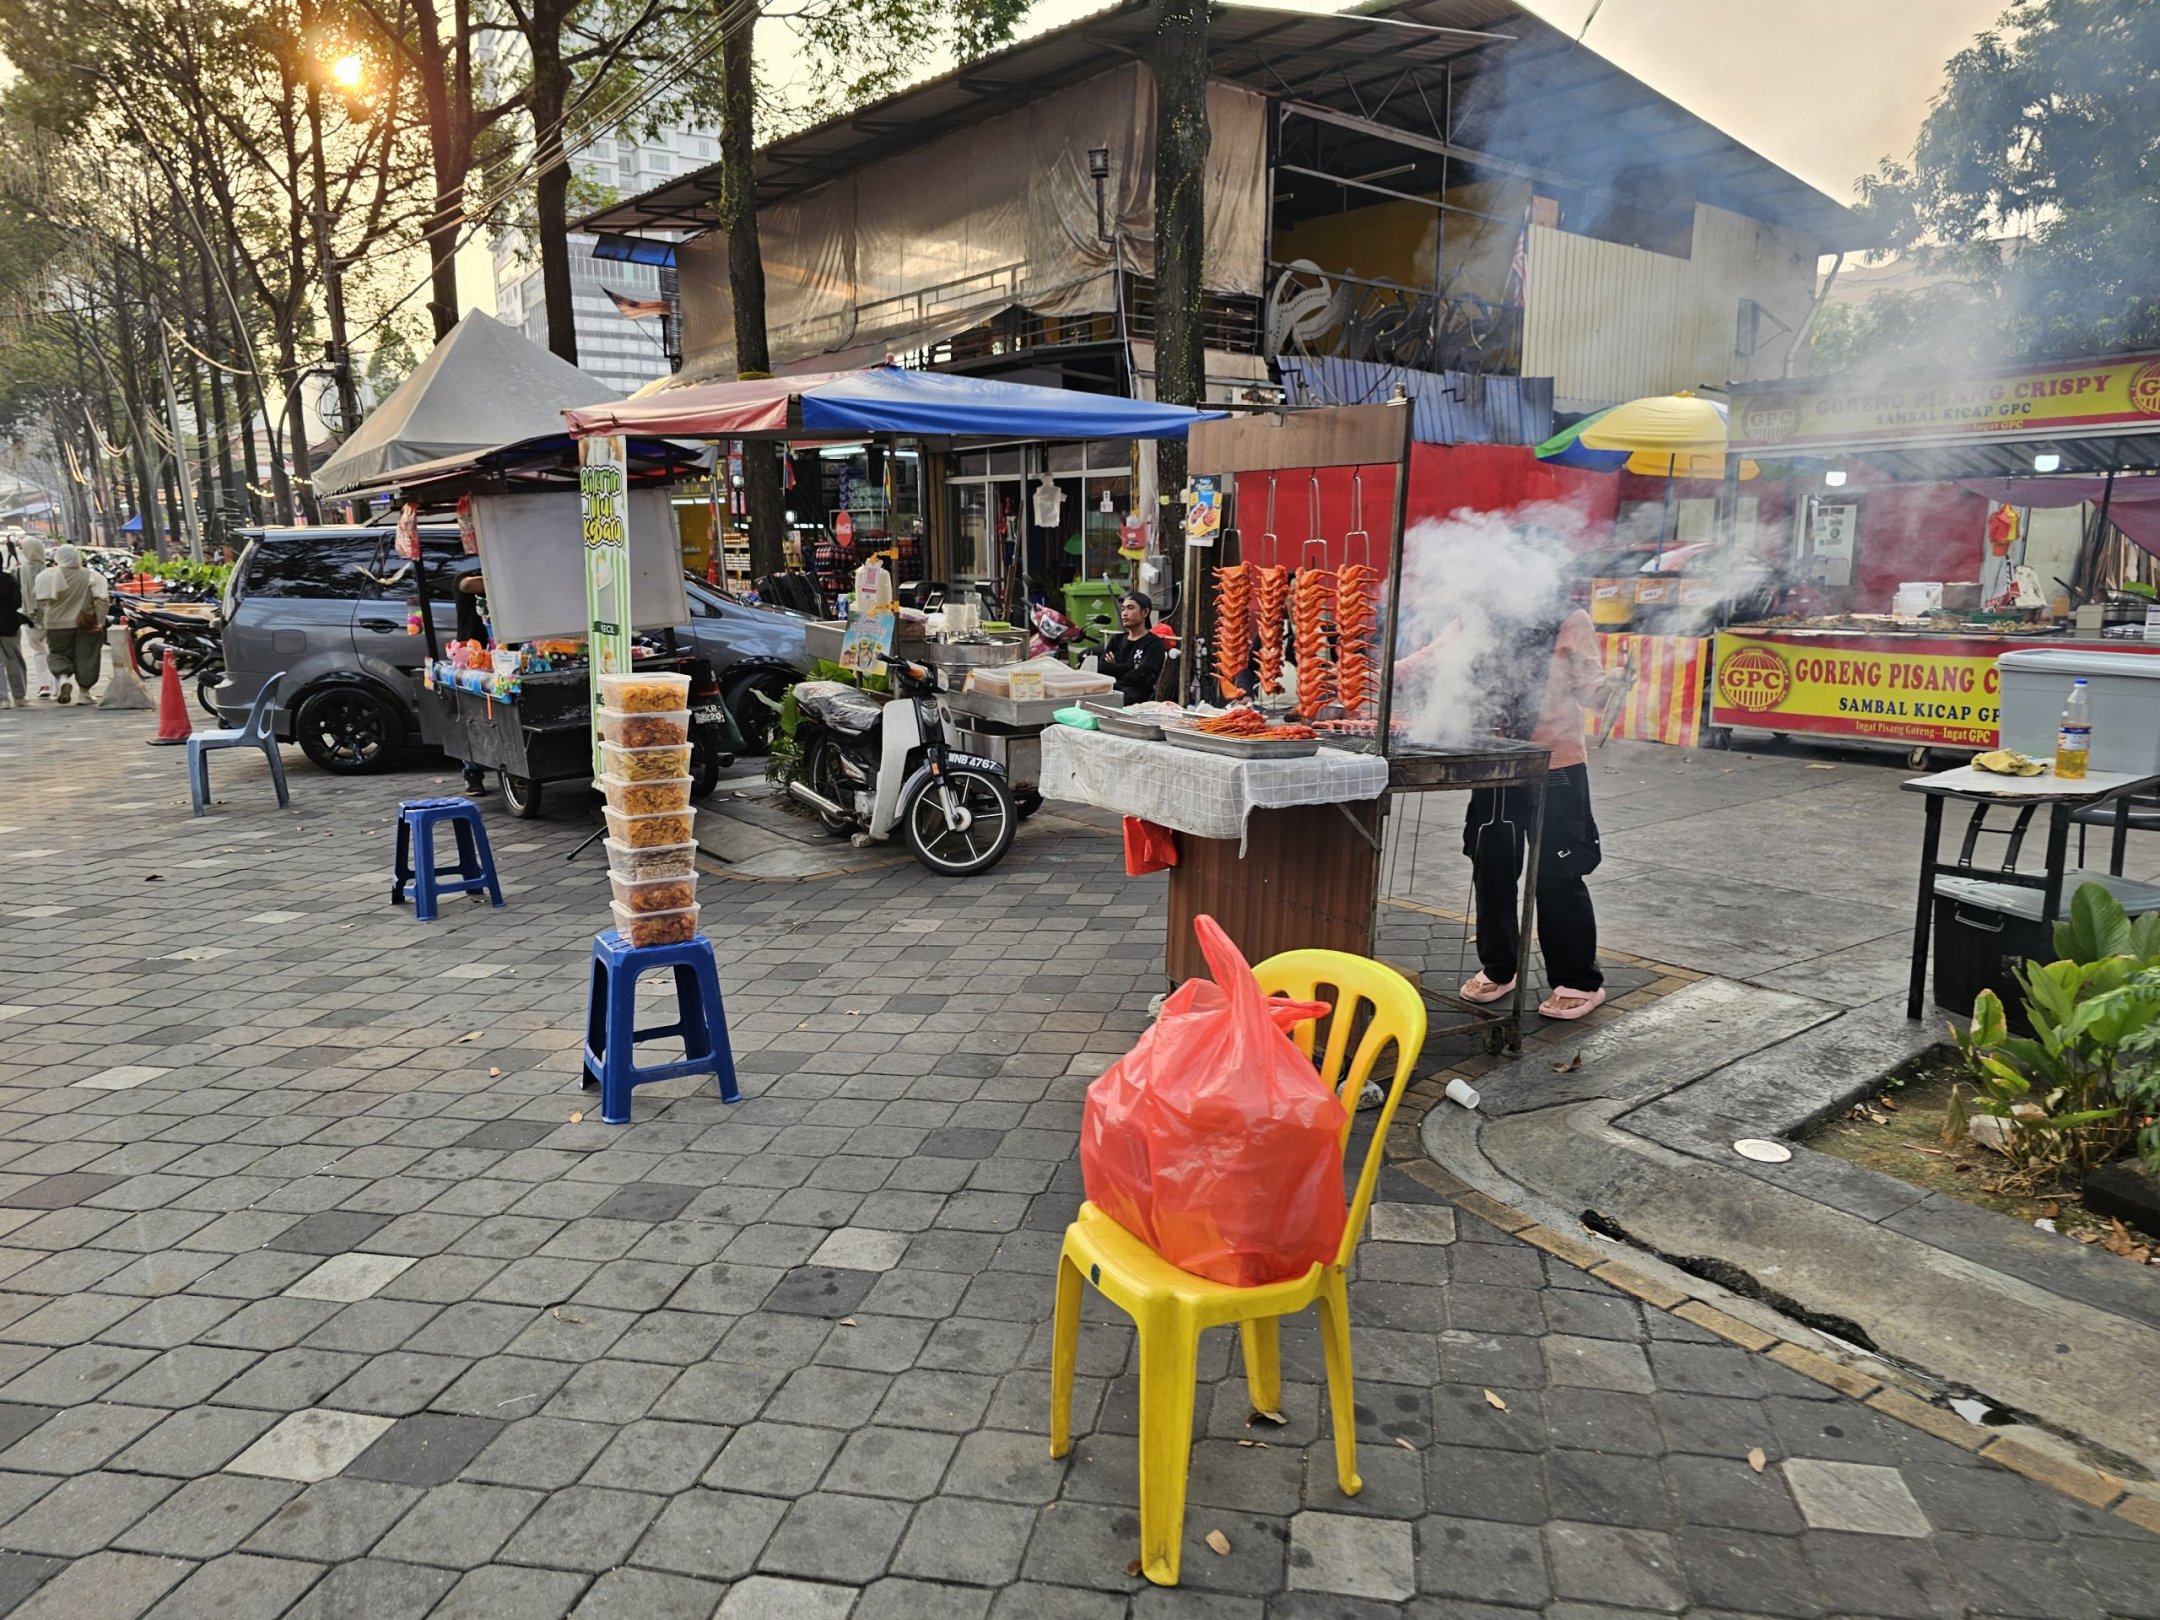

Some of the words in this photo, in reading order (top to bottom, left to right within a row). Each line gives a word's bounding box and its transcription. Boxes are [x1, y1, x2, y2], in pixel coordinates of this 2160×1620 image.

[1816, 393, 1905, 416] GORENG
[1915, 383, 2004, 409] PISANG
[2014, 374, 2112, 399] CRISPY
[1750, 411, 1793, 427] GPC
[1876, 412, 1937, 425] SAMBAL
[1943, 405, 1993, 420] KICAP
[1999, 402, 2032, 415] GPC
[2000, 420, 2024, 429] GPC
[1727, 669, 1781, 690] GPC
[1795, 658, 1882, 689] GORENG
[1888, 663, 1975, 694] PISANG
[1983, 668, 2000, 695] C
[1839, 697, 1908, 717] SAMBAL
[1913, 703, 1972, 721] KICAP
[1856, 720, 1876, 732] Ingat
[1878, 722, 1904, 736] Pisang
[1905, 724, 1935, 739] Goreng
[1943, 726, 1967, 741] Ingat
[1968, 728, 1991, 743] GPC
[968, 756, 998, 771] 4767
